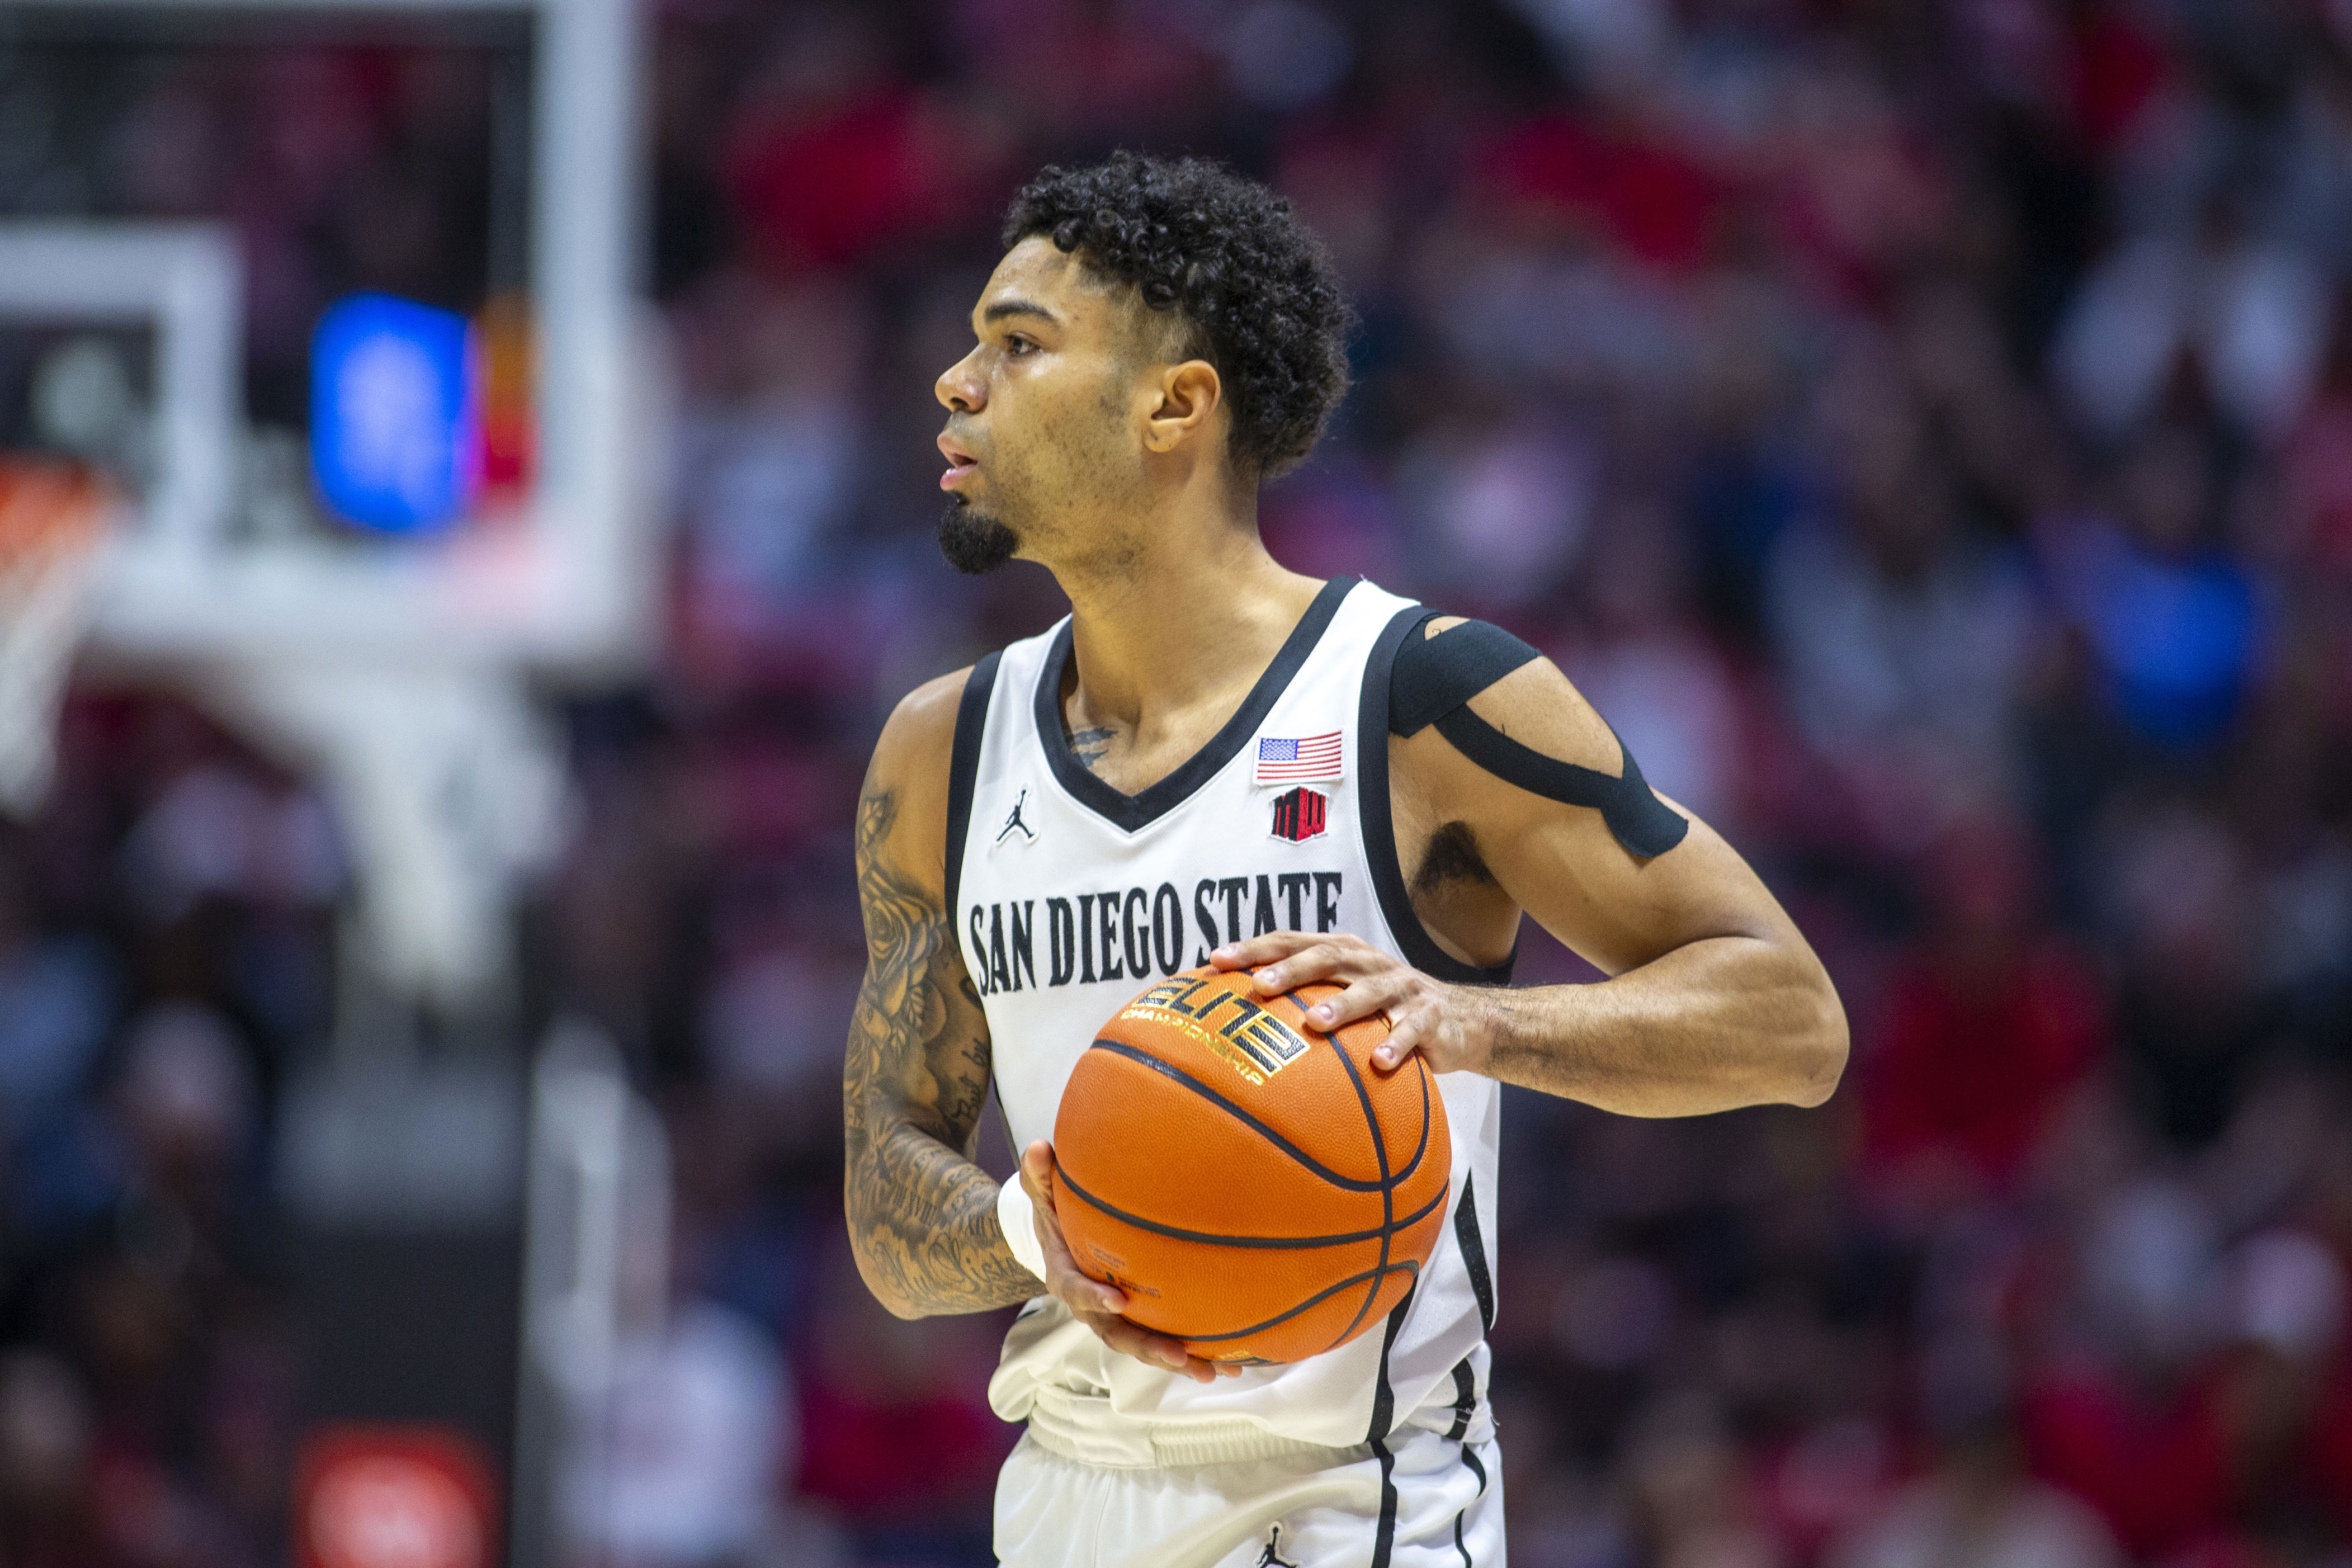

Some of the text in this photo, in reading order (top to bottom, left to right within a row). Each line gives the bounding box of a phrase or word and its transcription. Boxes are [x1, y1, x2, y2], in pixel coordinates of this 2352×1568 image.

[969, 871, 1343, 996] SAN DIEGO STATE
[1121, 1008, 1265, 1086] CHAMPIONSHIP
[1131, 976, 1311, 1078] ELITE
